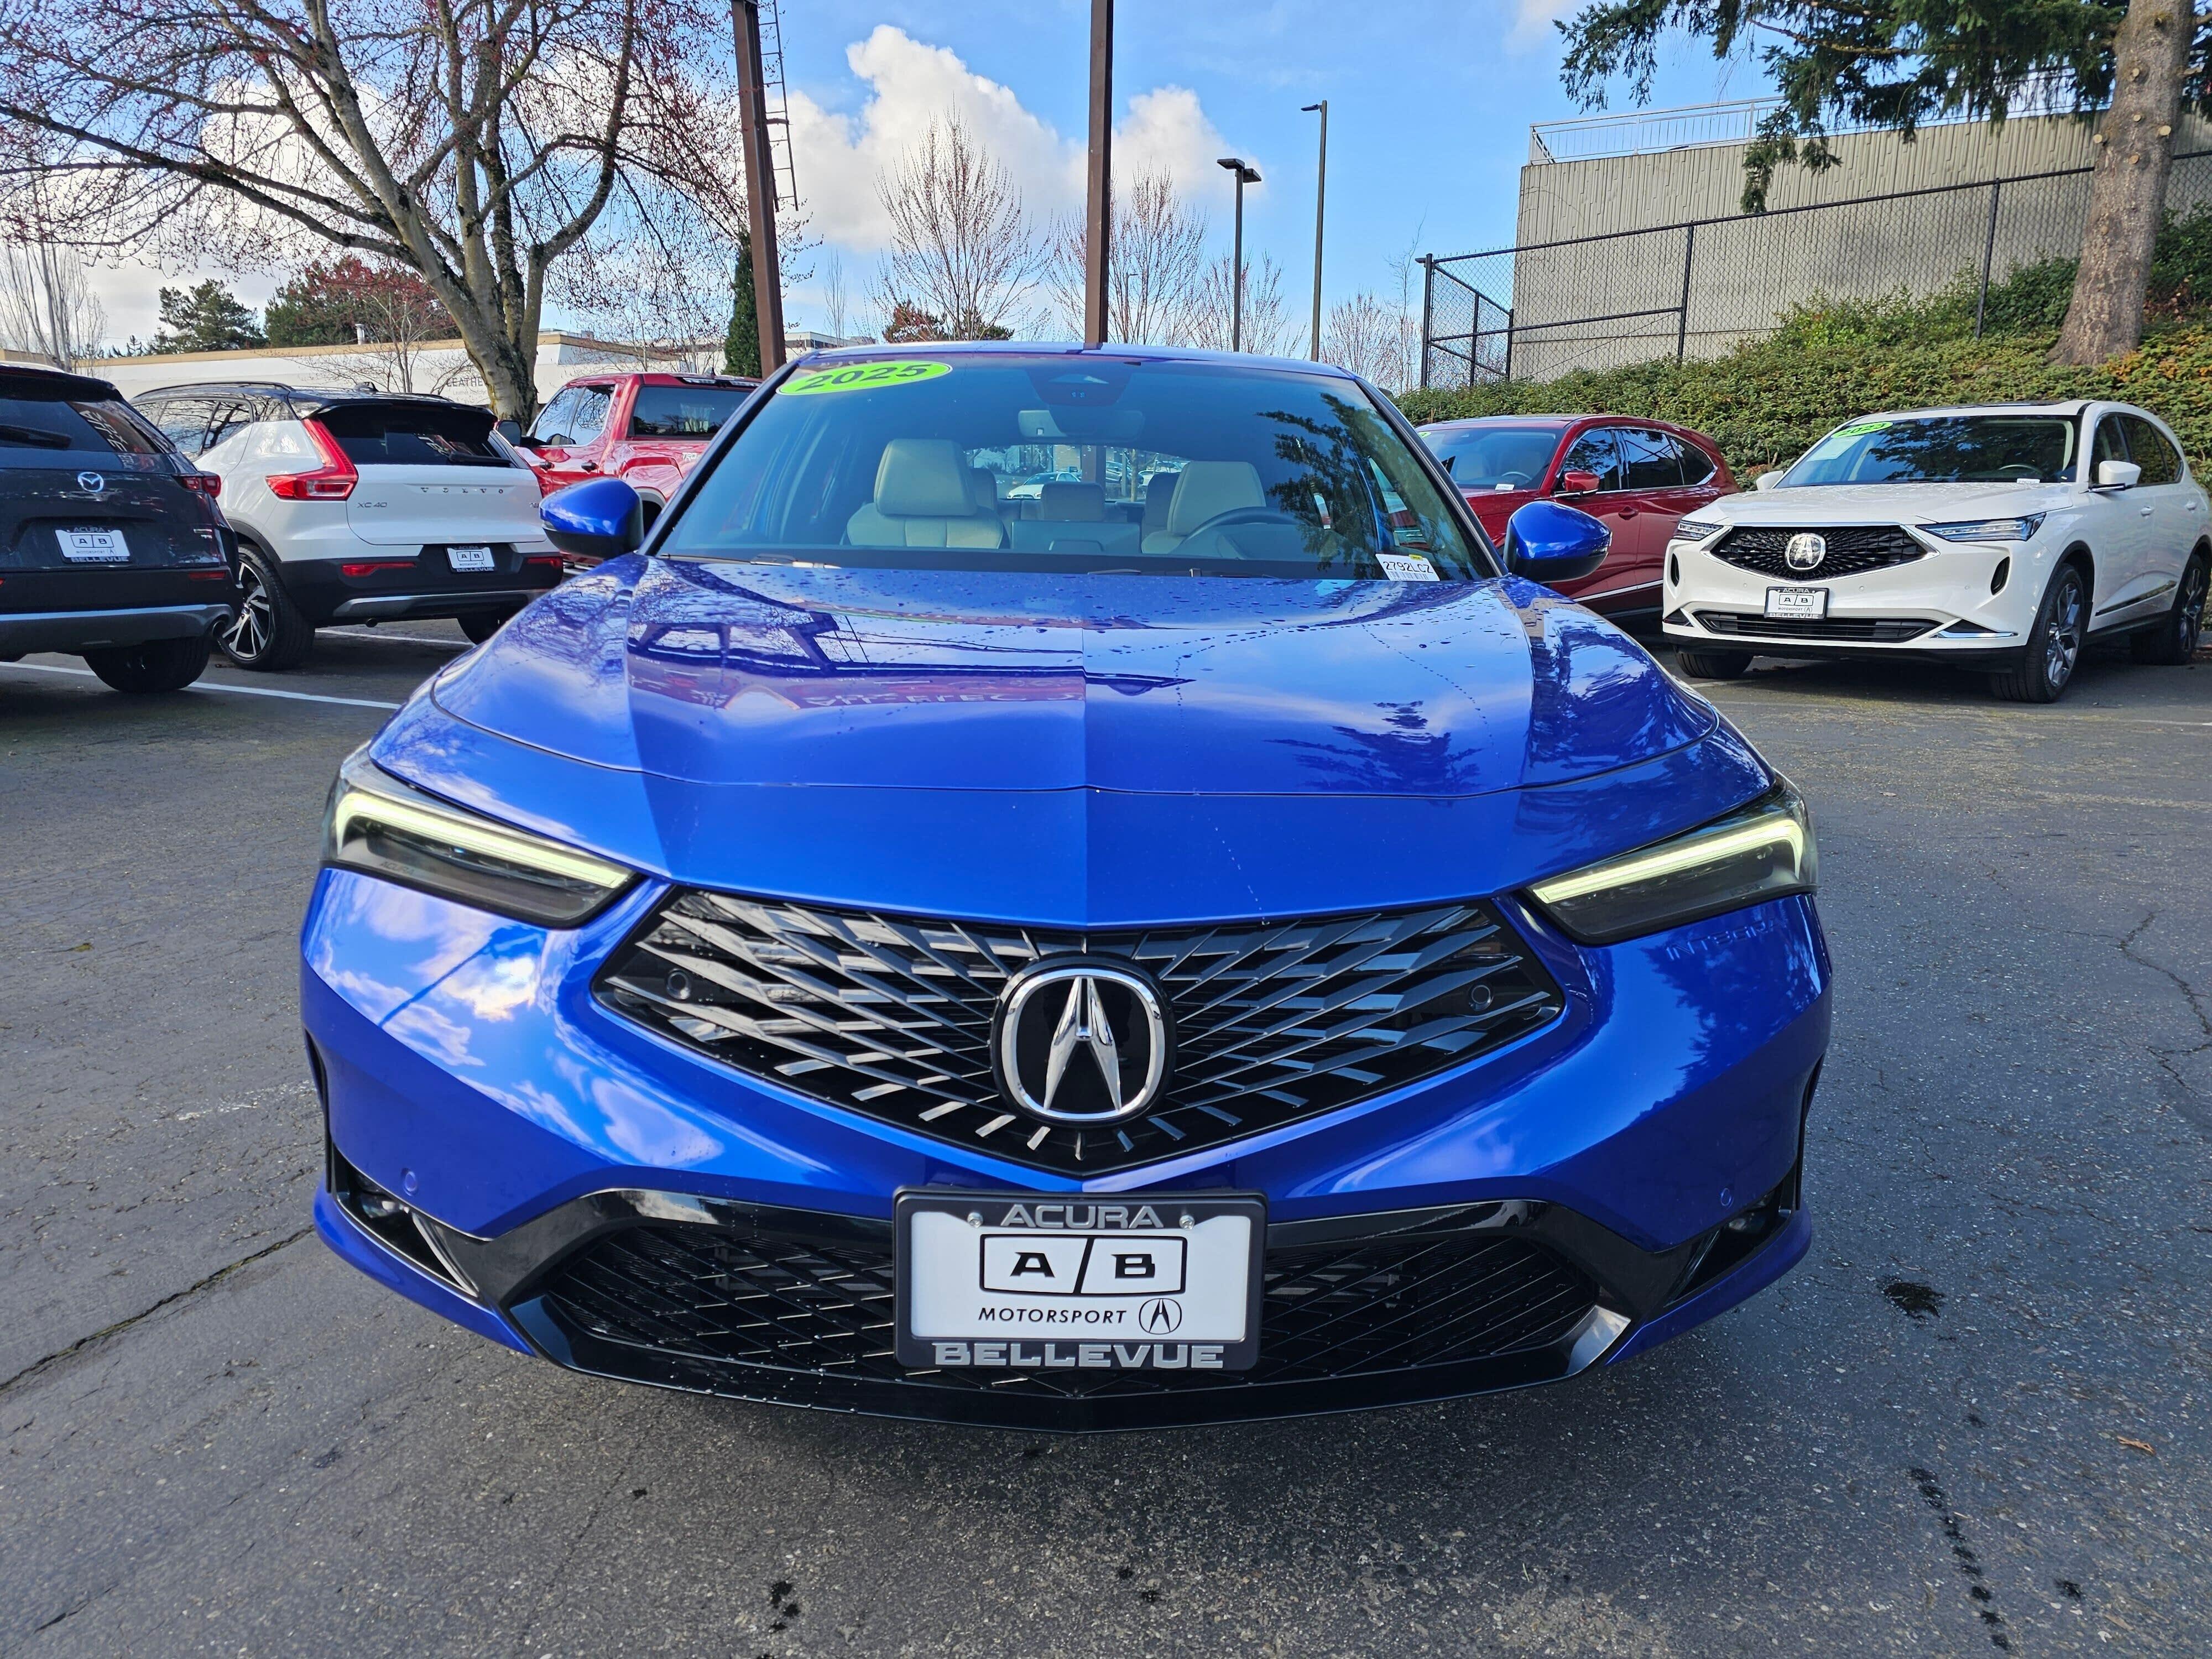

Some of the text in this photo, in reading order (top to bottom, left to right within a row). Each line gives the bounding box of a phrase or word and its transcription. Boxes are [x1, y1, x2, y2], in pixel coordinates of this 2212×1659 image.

[447, 378, 483, 387] LEATHE
[795, 364, 933, 392] 2025
[1000, 1204, 1164, 1229] ACURA
[1010, 1251, 1155, 1279] A B
[978, 1307, 1128, 1325] MOTORSPORT
[931, 1342, 1224, 1369] BELLEVUE
